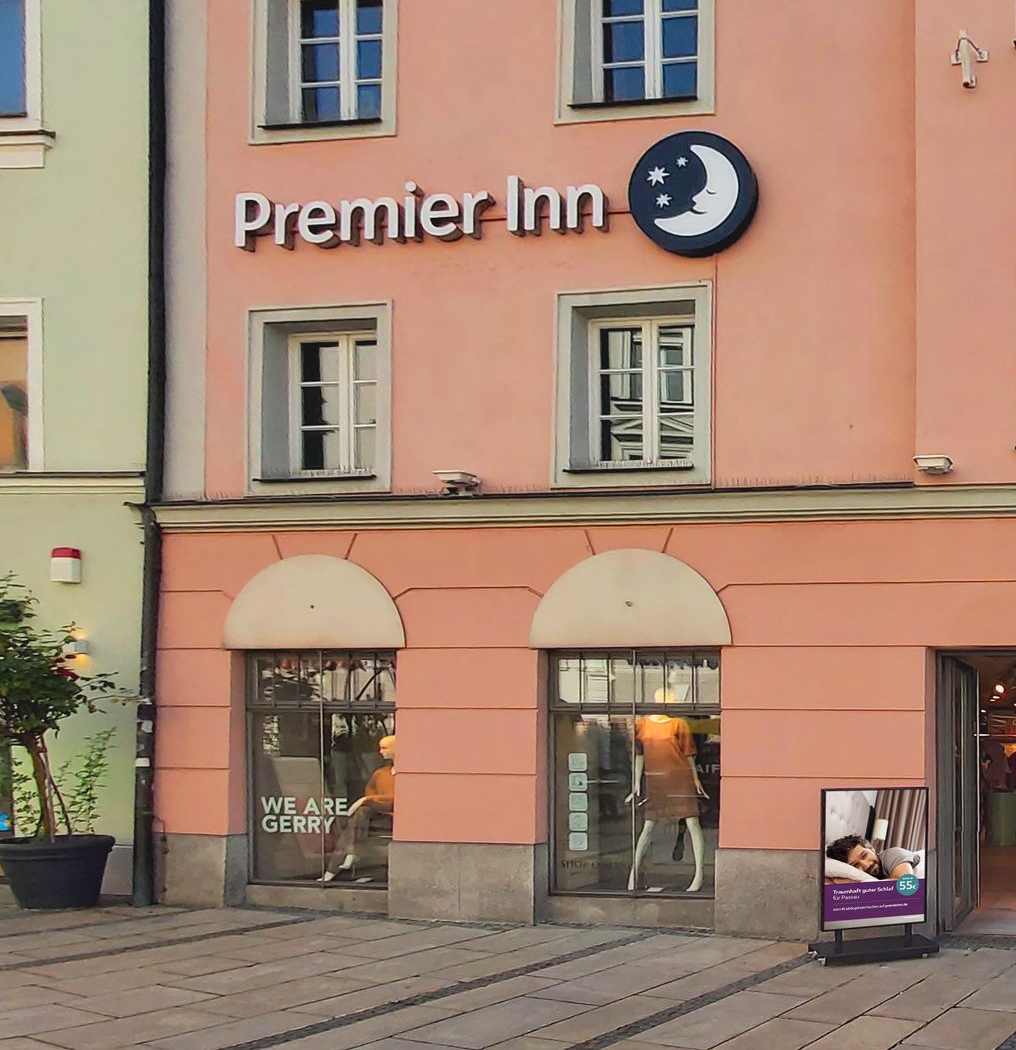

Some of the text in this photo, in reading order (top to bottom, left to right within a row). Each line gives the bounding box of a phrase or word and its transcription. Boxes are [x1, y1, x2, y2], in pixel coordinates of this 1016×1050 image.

[235, 175, 603, 248] Premier Inn
[261, 796, 348, 816] WE ARE
[261, 815, 335, 834] GERRY
